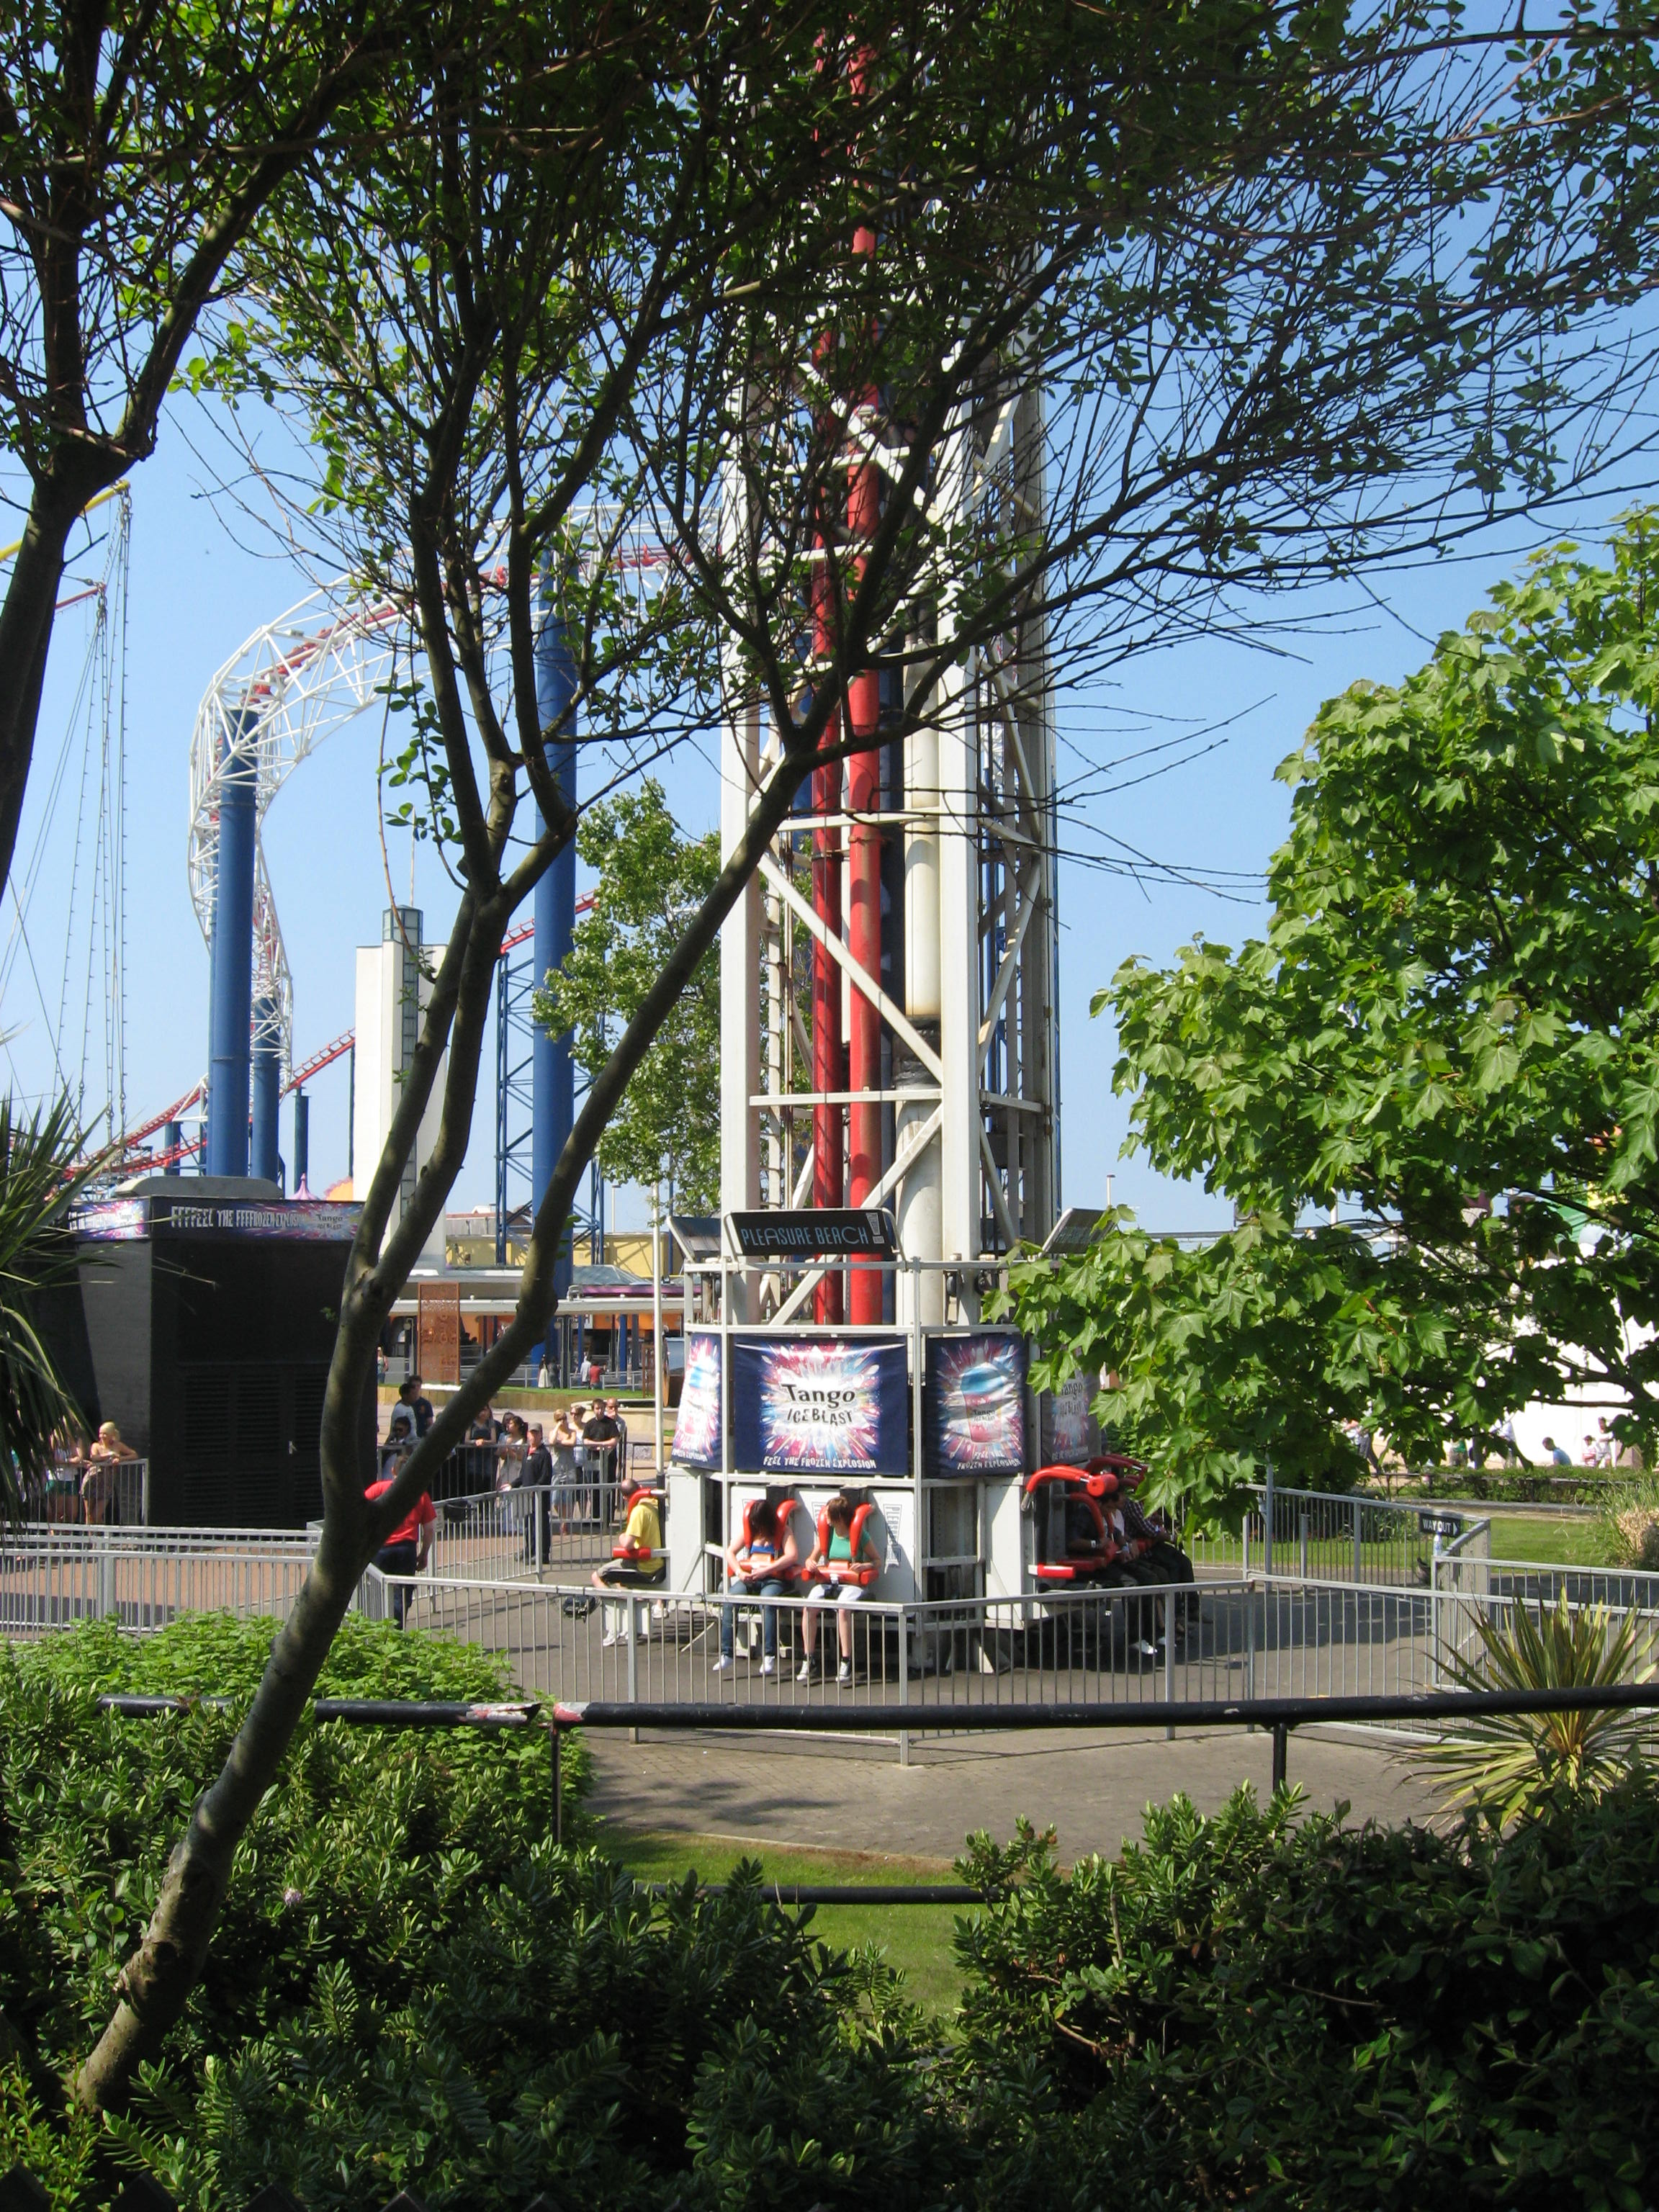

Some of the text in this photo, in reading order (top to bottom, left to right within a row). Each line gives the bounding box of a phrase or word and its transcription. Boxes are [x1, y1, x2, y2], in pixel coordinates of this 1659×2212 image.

[217, 1209, 234, 1228] THE
[316, 1214, 343, 1223] Tango
[740, 1227, 814, 1246] PLEASURE
[781, 1384, 855, 1409] Tango
[1061, 1382, 1083, 1400] ango
[763, 1456, 877, 1469] FEEL THE FROZEN EXPLOSION
[984, 1458, 1022, 1469] EXPLOSION
[1423, 1519, 1452, 1534] WAY OUT
